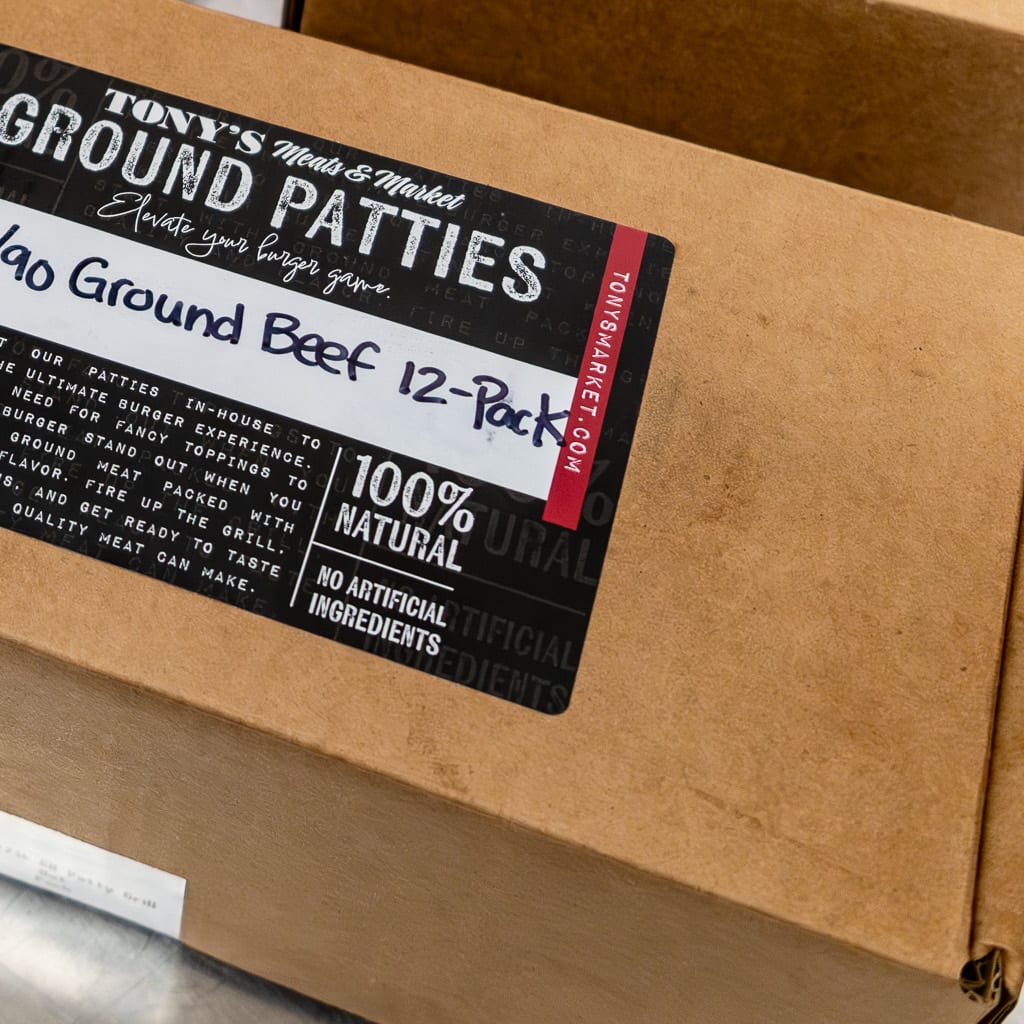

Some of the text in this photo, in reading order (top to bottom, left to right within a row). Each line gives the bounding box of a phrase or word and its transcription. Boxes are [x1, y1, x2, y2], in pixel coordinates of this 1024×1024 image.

[104, 87, 466, 211] TONY'S Meats & Market
[96, 191, 391, 299] Elevate your burger game.
[269, 175, 546, 303] PATTIES
[31, 348, 64, 367] OUR
[87, 366, 160, 397] PATTIES
[185, 398, 274, 435] IN-HOUSE
[301, 433, 321, 450] TO
[68, 256, 245, 345] Ground
[261, 312, 381, 382] Beef
[398, 361, 568, 449] 12-Pack
[563, 271, 631, 473] TONYSMARKET.COM
[2, 405, 68, 435] BURGER
[84, 432, 137, 458] STAND
[154, 455, 188, 473] OUT
[204, 470, 251, 496] WHEN
[270, 491, 302, 511] YOU
[11, 385, 54, 408] NEED
[69, 404, 101, 423] FOR
[115, 419, 169, 444] FANCY
[185, 440, 271, 479] TOPPINGS
[288, 474, 308, 491] TO
[26, 367, 109, 404] ULTIMATE
[118, 398, 185, 428] BURGER
[194, 422, 311, 469] EXPERIENCE.
[10, 431, 76, 461] GROUND
[96, 460, 142, 482] MEAT
[162, 480, 228, 511] PACKED
[250, 509, 295, 534] WITH
[34, 486, 68, 506] AND
[79, 501, 113, 520] GET
[124, 515, 180, 542] READY
[193, 537, 213, 554] TO
[228, 548, 281, 578] TASTE
[85, 479, 128, 502] FIRE
[140, 496, 163, 512] UP
[177, 507, 209, 529] THE
[222, 524, 284, 555] GRILL.
[351, 454, 475, 533] 100%
[12, 502, 89, 536] QUALITY
[98, 532, 145, 554] MEAT
[156, 551, 190, 572] CAN
[201, 566, 255, 593] MAKE.
[334, 502, 462, 573] NATURAL
[308, 592, 441, 656] INGREDIENTS
[316, 565, 447, 628] NO ARTIFICIAL
